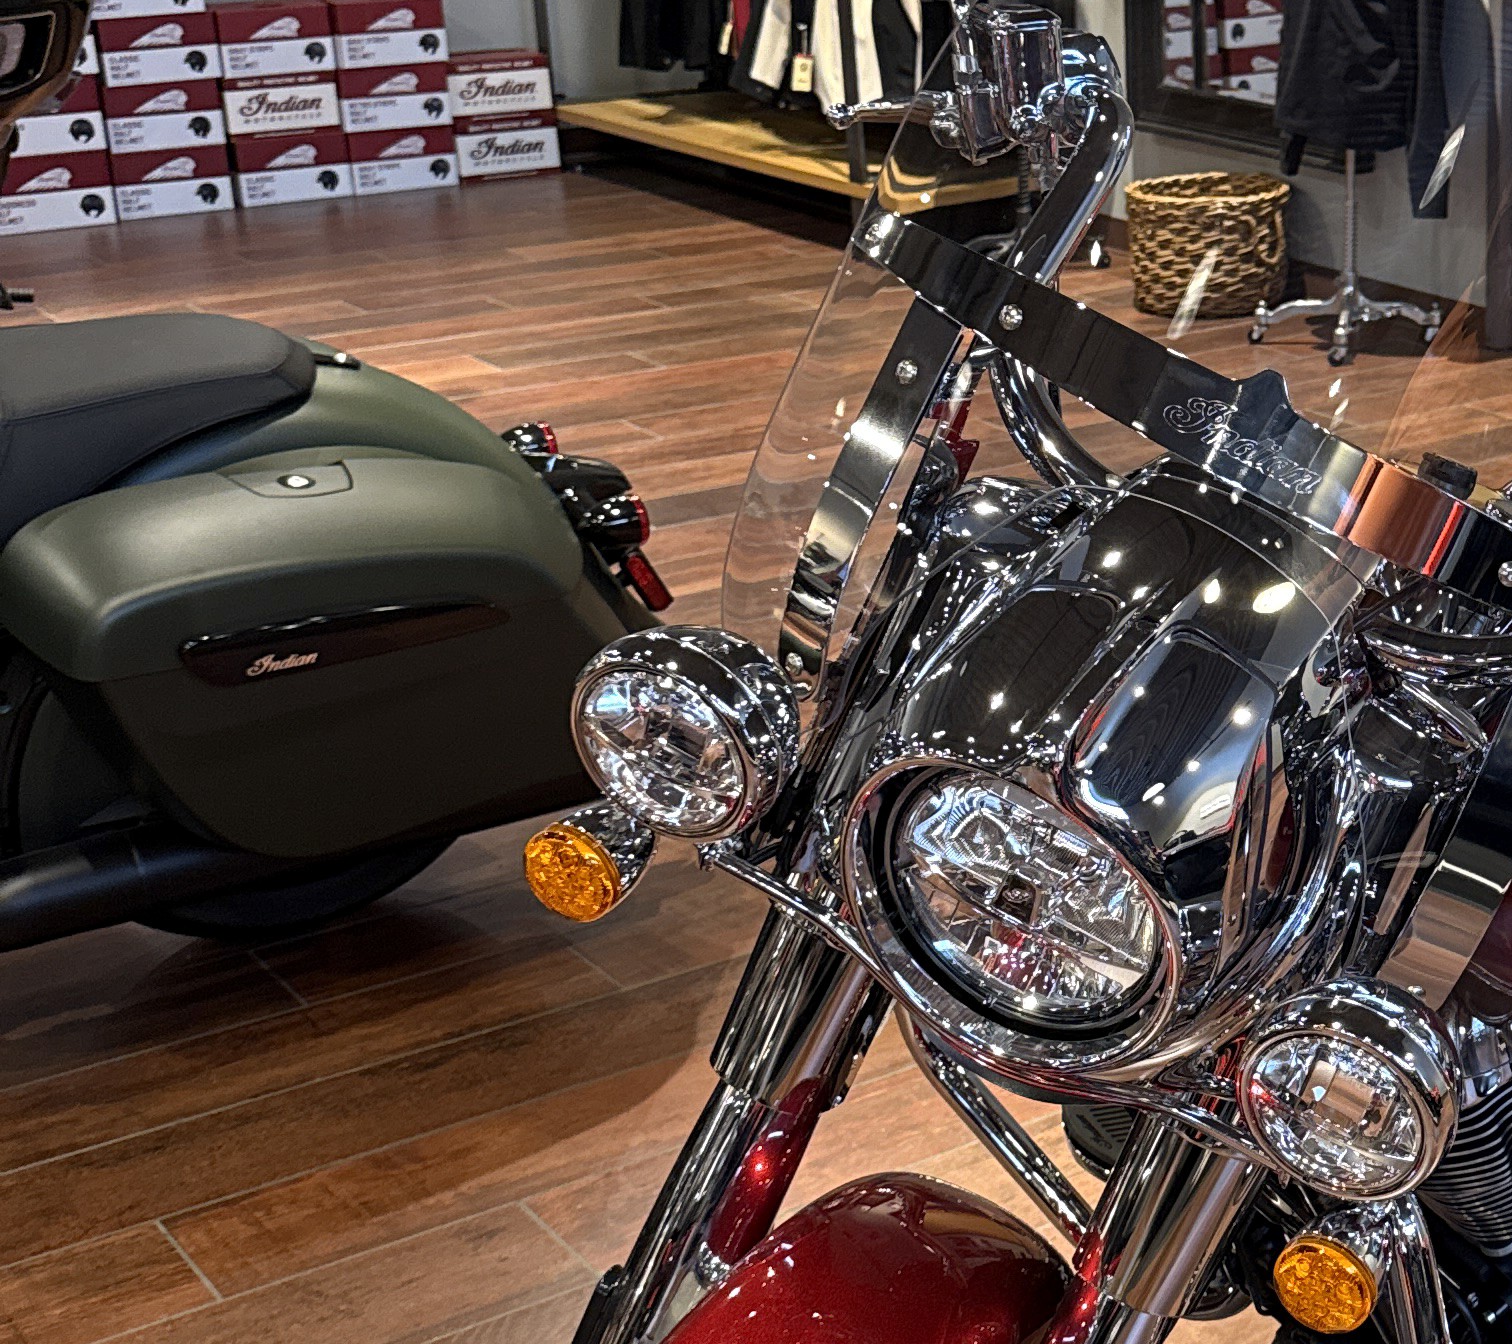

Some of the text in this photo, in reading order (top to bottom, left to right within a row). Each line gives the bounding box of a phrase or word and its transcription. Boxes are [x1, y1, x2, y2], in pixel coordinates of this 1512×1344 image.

[459, 76, 537, 100] Indian
[239, 91, 322, 117] Indian
[470, 136, 545, 160] Indian
[1163, 397, 1323, 495] Indian
[246, 652, 319, 677] Indian
